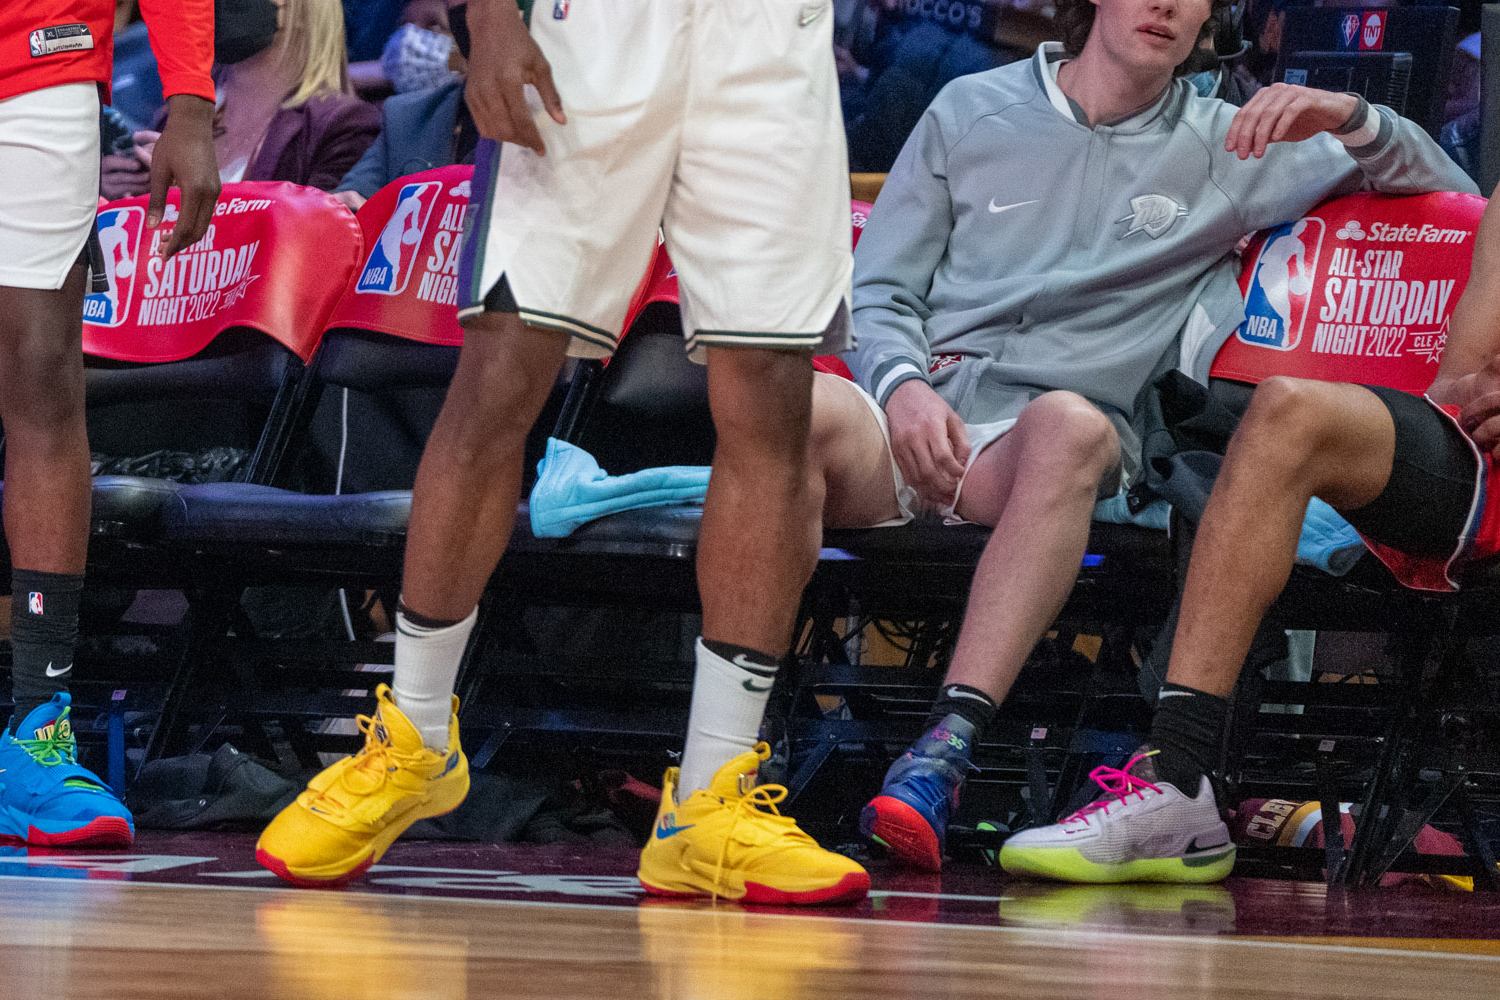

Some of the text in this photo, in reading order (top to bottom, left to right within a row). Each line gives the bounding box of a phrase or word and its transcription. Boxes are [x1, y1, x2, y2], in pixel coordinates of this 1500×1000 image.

[143, 240, 260, 298] SATURDAY
[362, 267, 388, 286] NBA
[417, 271, 459, 306] NIGH
[1319, 277, 1456, 326] SATURDAY
[1246, 314, 1278, 340] NBA
[1413, 335, 1432, 348] CLE
